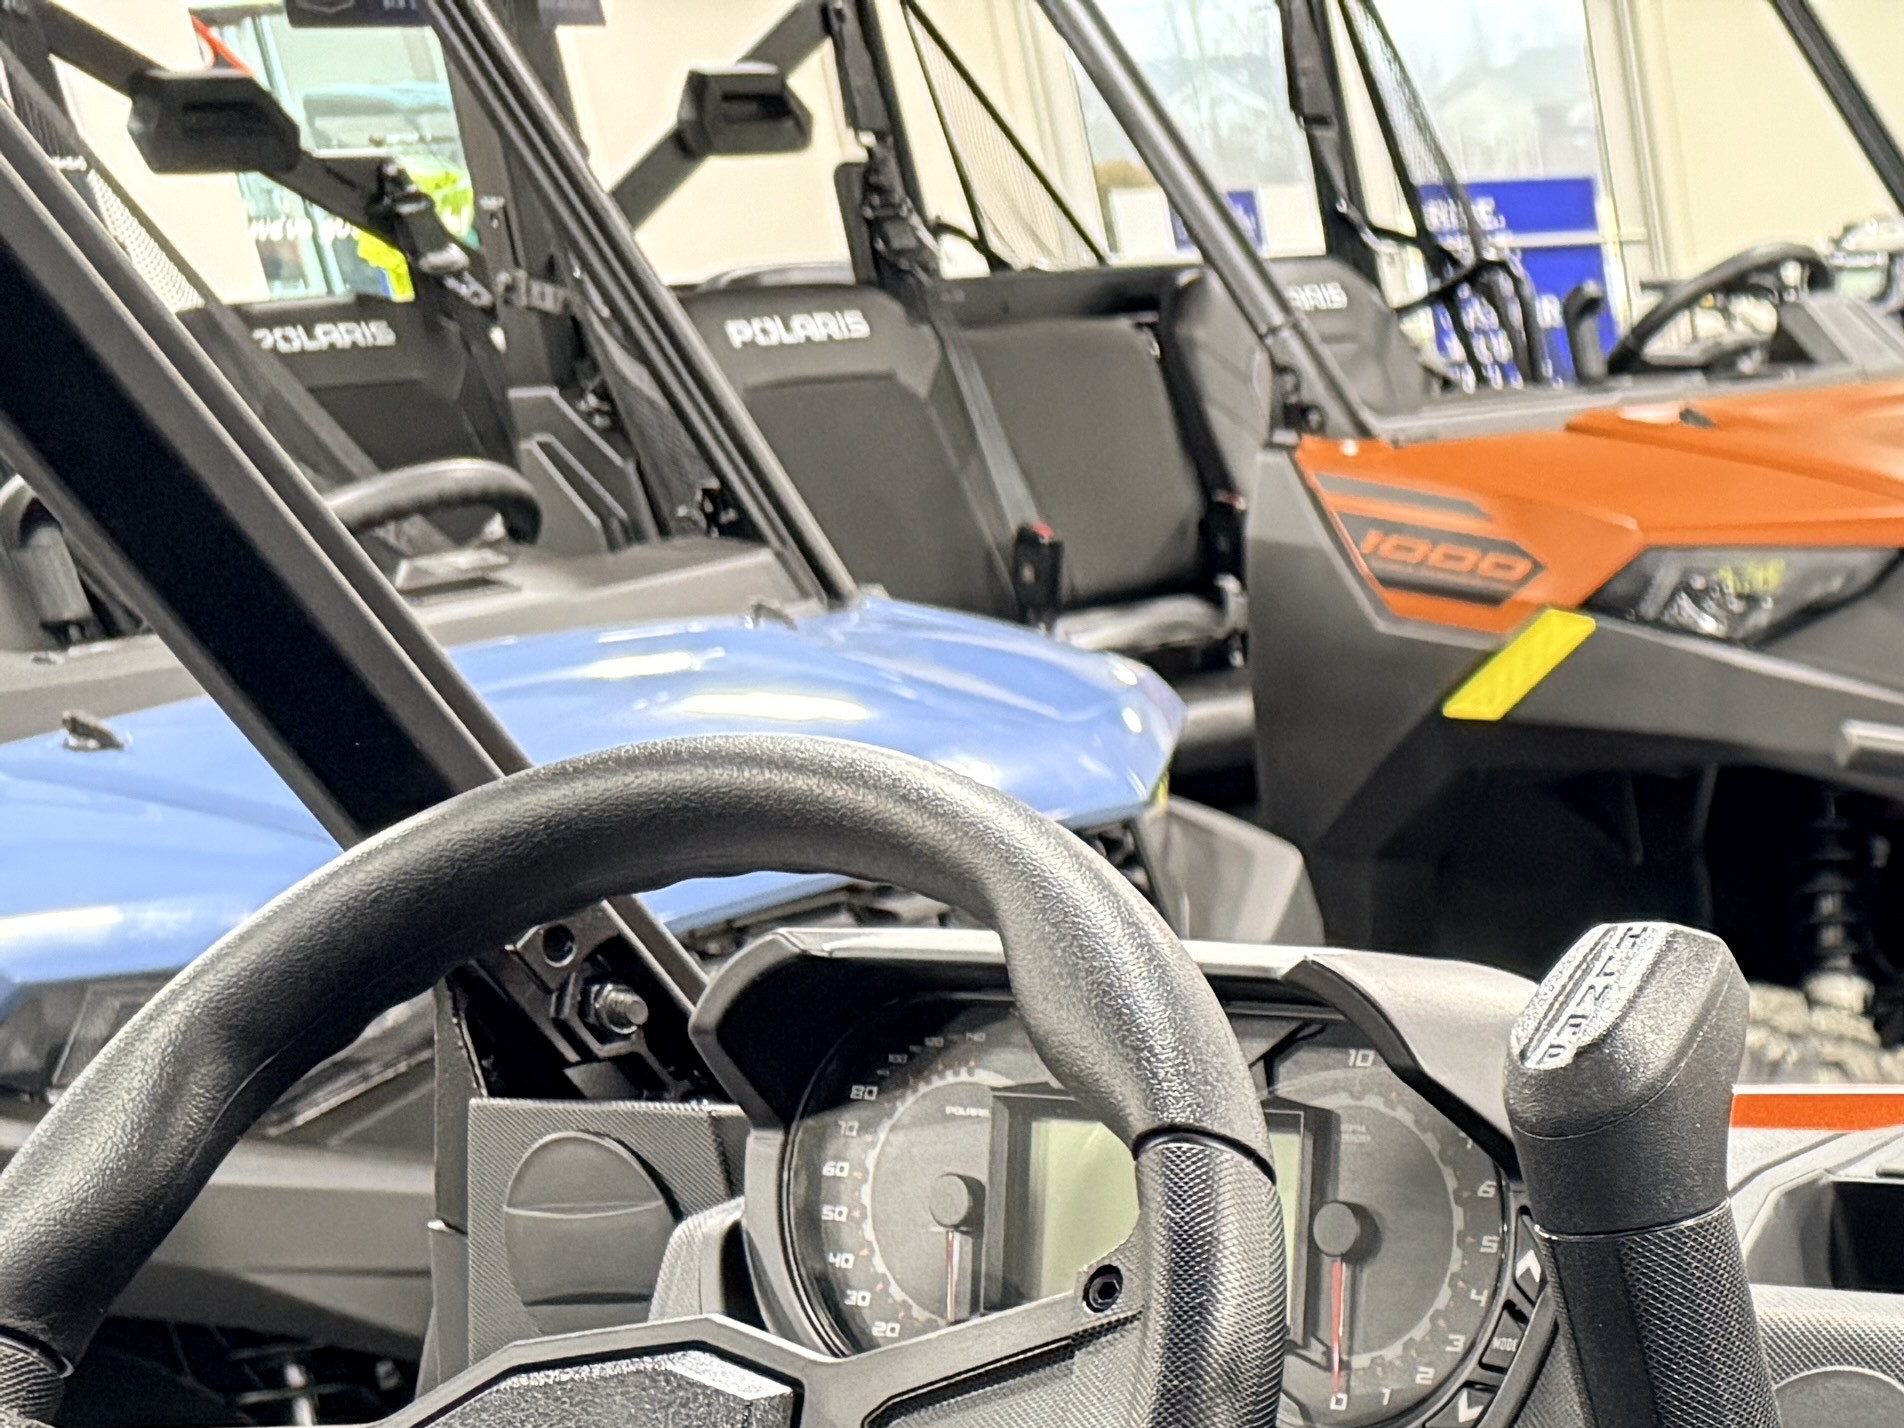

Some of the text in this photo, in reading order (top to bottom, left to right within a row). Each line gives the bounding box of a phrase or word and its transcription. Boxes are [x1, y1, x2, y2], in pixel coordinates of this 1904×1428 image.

[724, 309, 871, 349] POLARIS
[1360, 529, 1534, 582] 1000
[1349, 1049, 1376, 1067] 10
[850, 1084, 878, 1100] 80
[838, 1120, 859, 1137] 70
[822, 1161, 850, 1178] 60
[1477, 1180, 1497, 1198] 6
[821, 1204, 848, 1222] 50
[1479, 1235, 1500, 1254] 5
[828, 1252, 855, 1269] 40
[844, 1289, 871, 1307] 30
[1470, 1288, 1489, 1307] 4
[871, 1321, 901, 1338] 20
[1445, 1334, 1466, 1353] 3
[1492, 1336, 1518, 1351] MODE
[1414, 1365, 1435, 1385] 2
[1329, 1392, 1348, 1411] 0
[1381, 1387, 1392, 1406] 1
